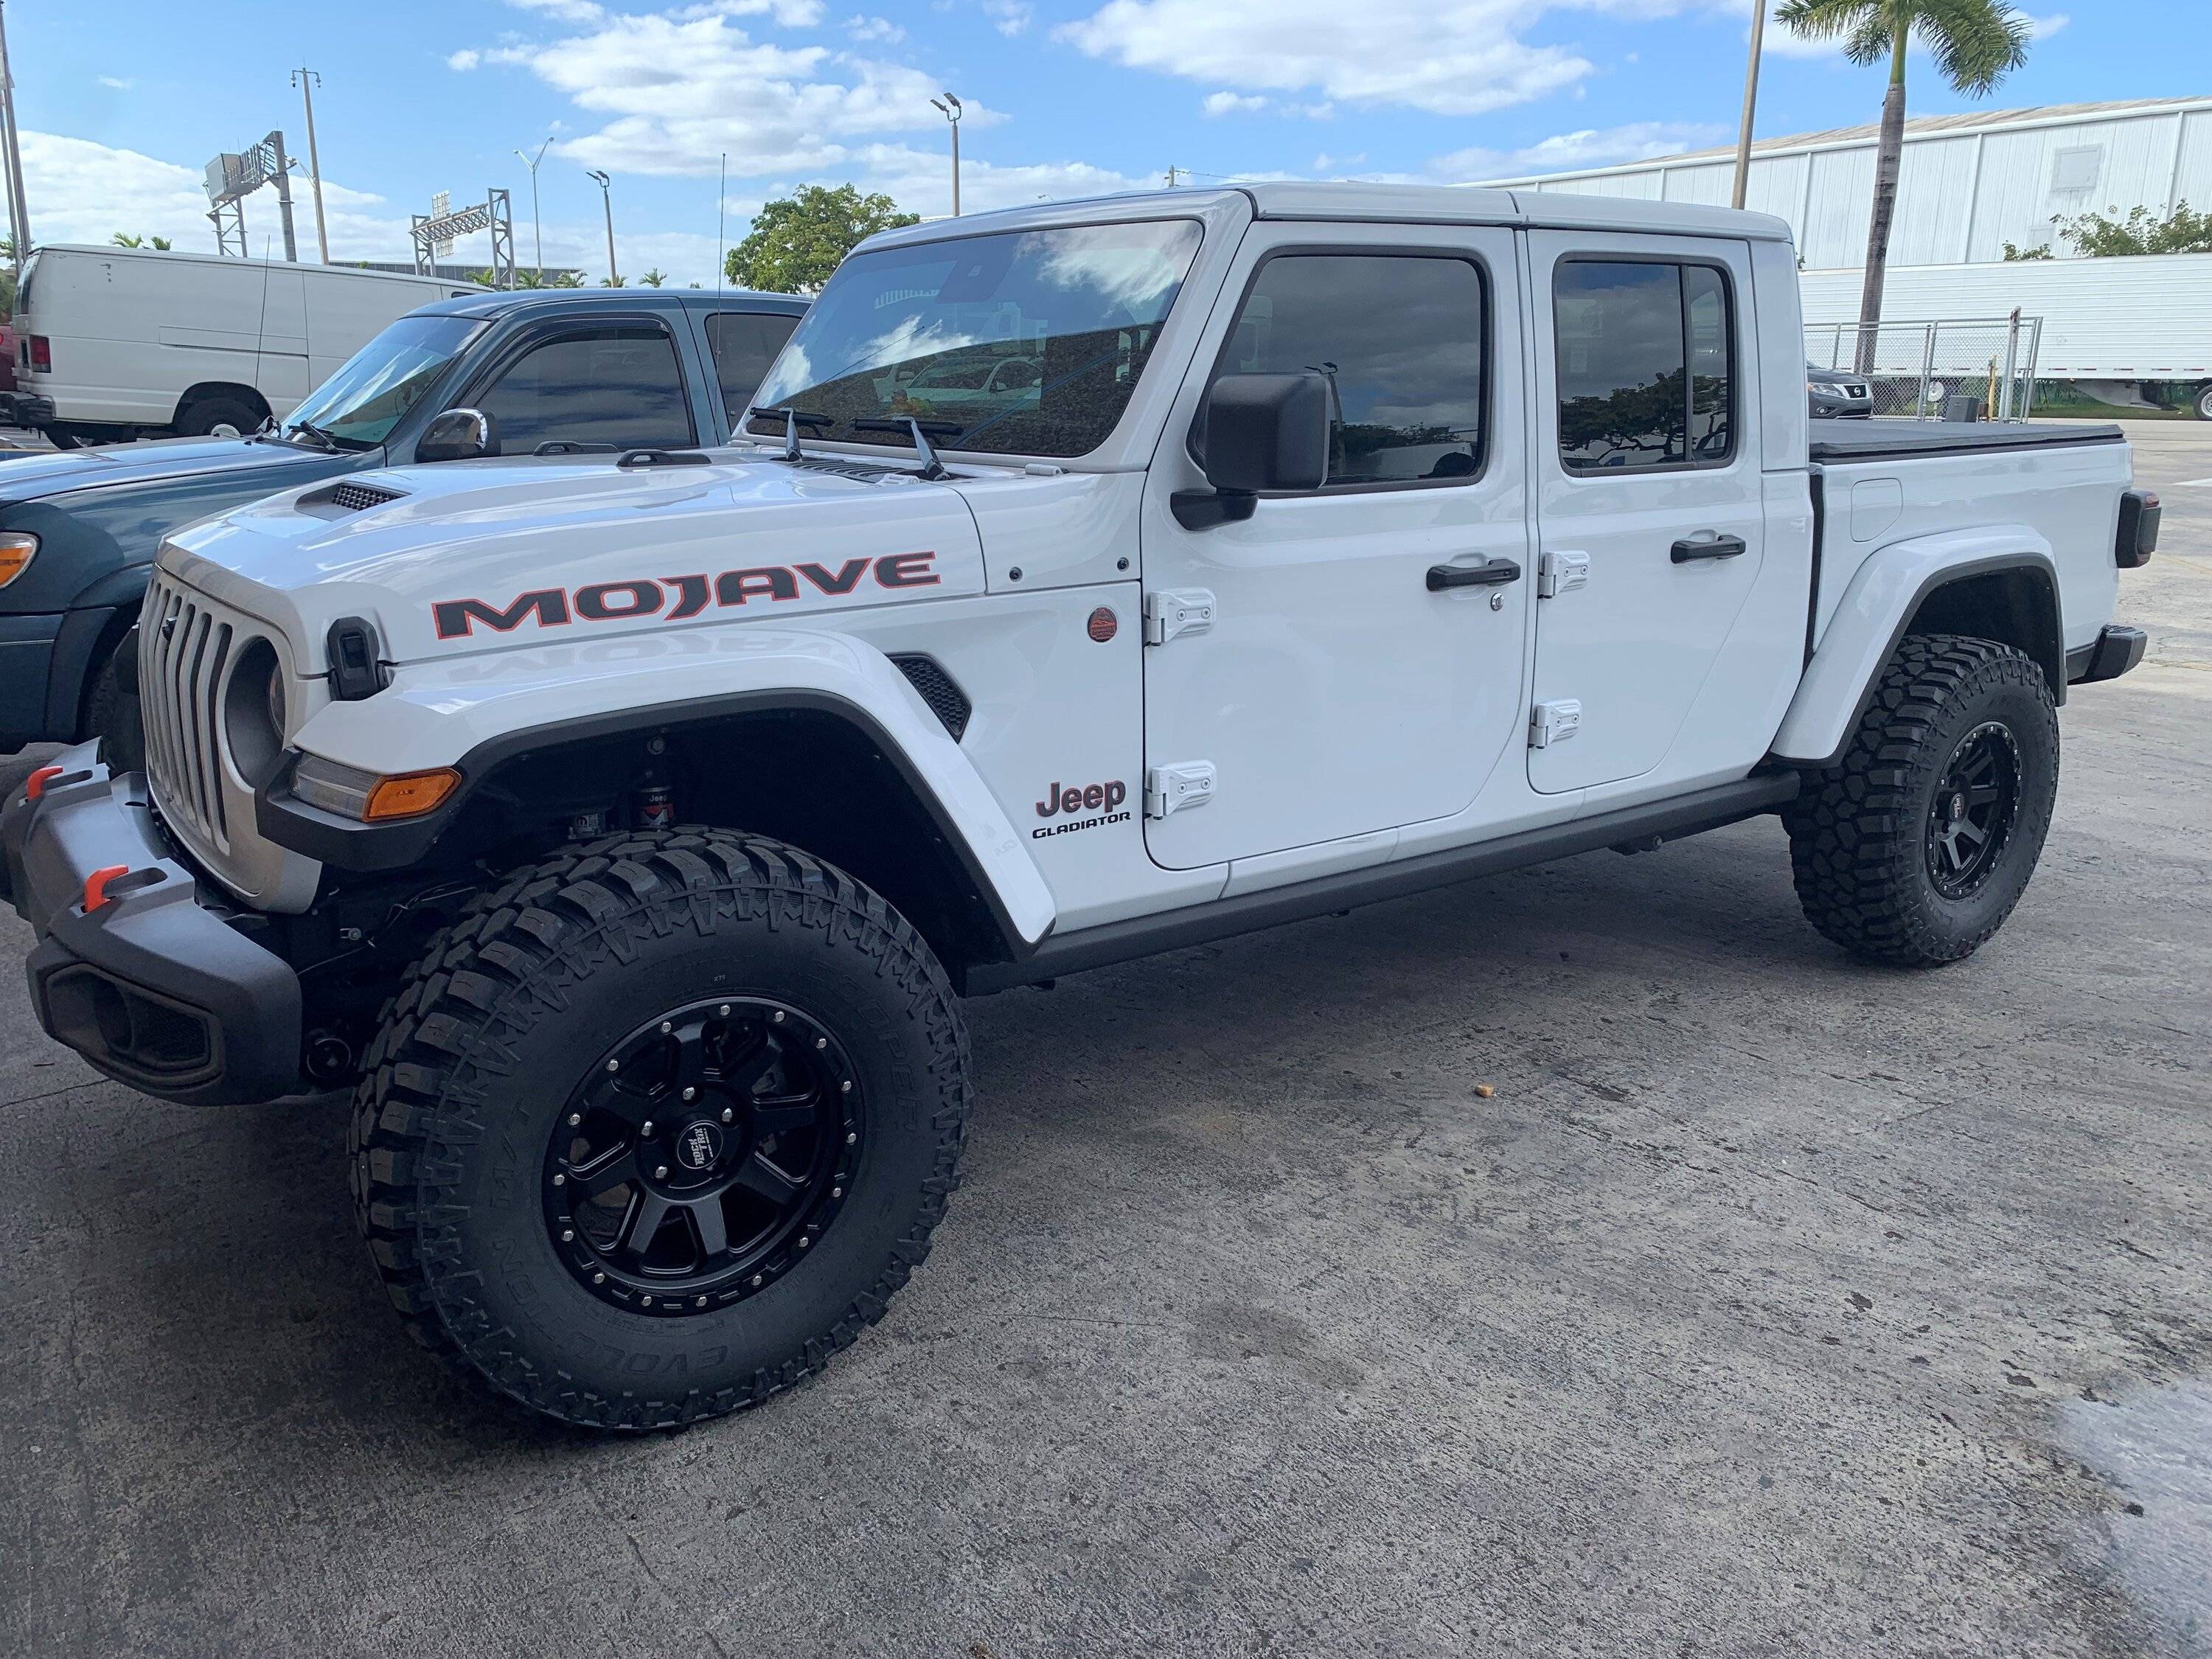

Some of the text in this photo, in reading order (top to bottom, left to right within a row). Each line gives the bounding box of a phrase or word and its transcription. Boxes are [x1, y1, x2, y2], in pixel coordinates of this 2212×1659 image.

[431, 551, 941, 640] MOJAVE
[1035, 780, 1127, 818] Jeep
[1032, 811, 1131, 839] GLADIATOR
